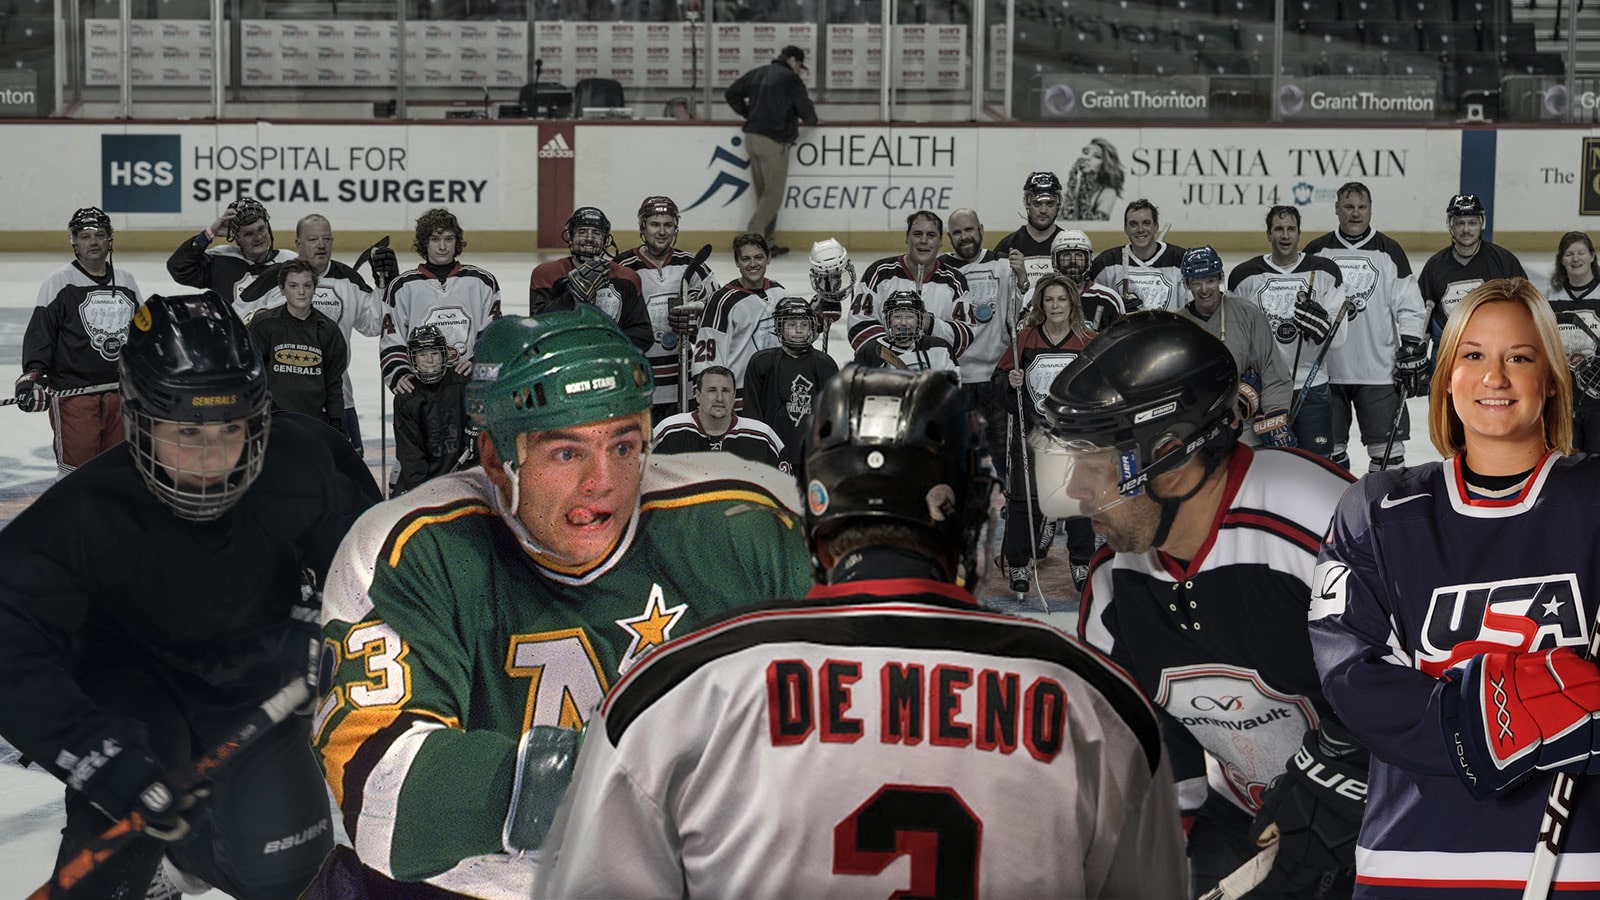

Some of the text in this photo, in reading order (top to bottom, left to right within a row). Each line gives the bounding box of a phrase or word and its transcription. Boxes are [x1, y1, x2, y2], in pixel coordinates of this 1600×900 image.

[1082, 90, 1206, 108] Grant Thornton
[1310, 92, 1434, 112] Grant Thornton
[195, 146, 406, 172] HOSPITAL FOR
[538, 150, 574, 159] adidas
[794, 135, 954, 166] oHEALTH
[1130, 147, 1410, 177] SHANIA TWAIN
[111, 161, 173, 186] HSS
[1540, 168, 1575, 184] The
[193, 178, 488, 203] SPECIAL SURGERY
[882, 186, 953, 210] CARE
[1182, 183, 1281, 206] JULY 14
[850, 294, 874, 316] 44
[694, 338, 716, 364] 29
[274, 364, 322, 376] GENERALS
[192, 395, 237, 406] GENERALS
[1417, 573, 1589, 672] USA
[766, 658, 1068, 764] DE MENO
[264, 818, 328, 854] BAUER
